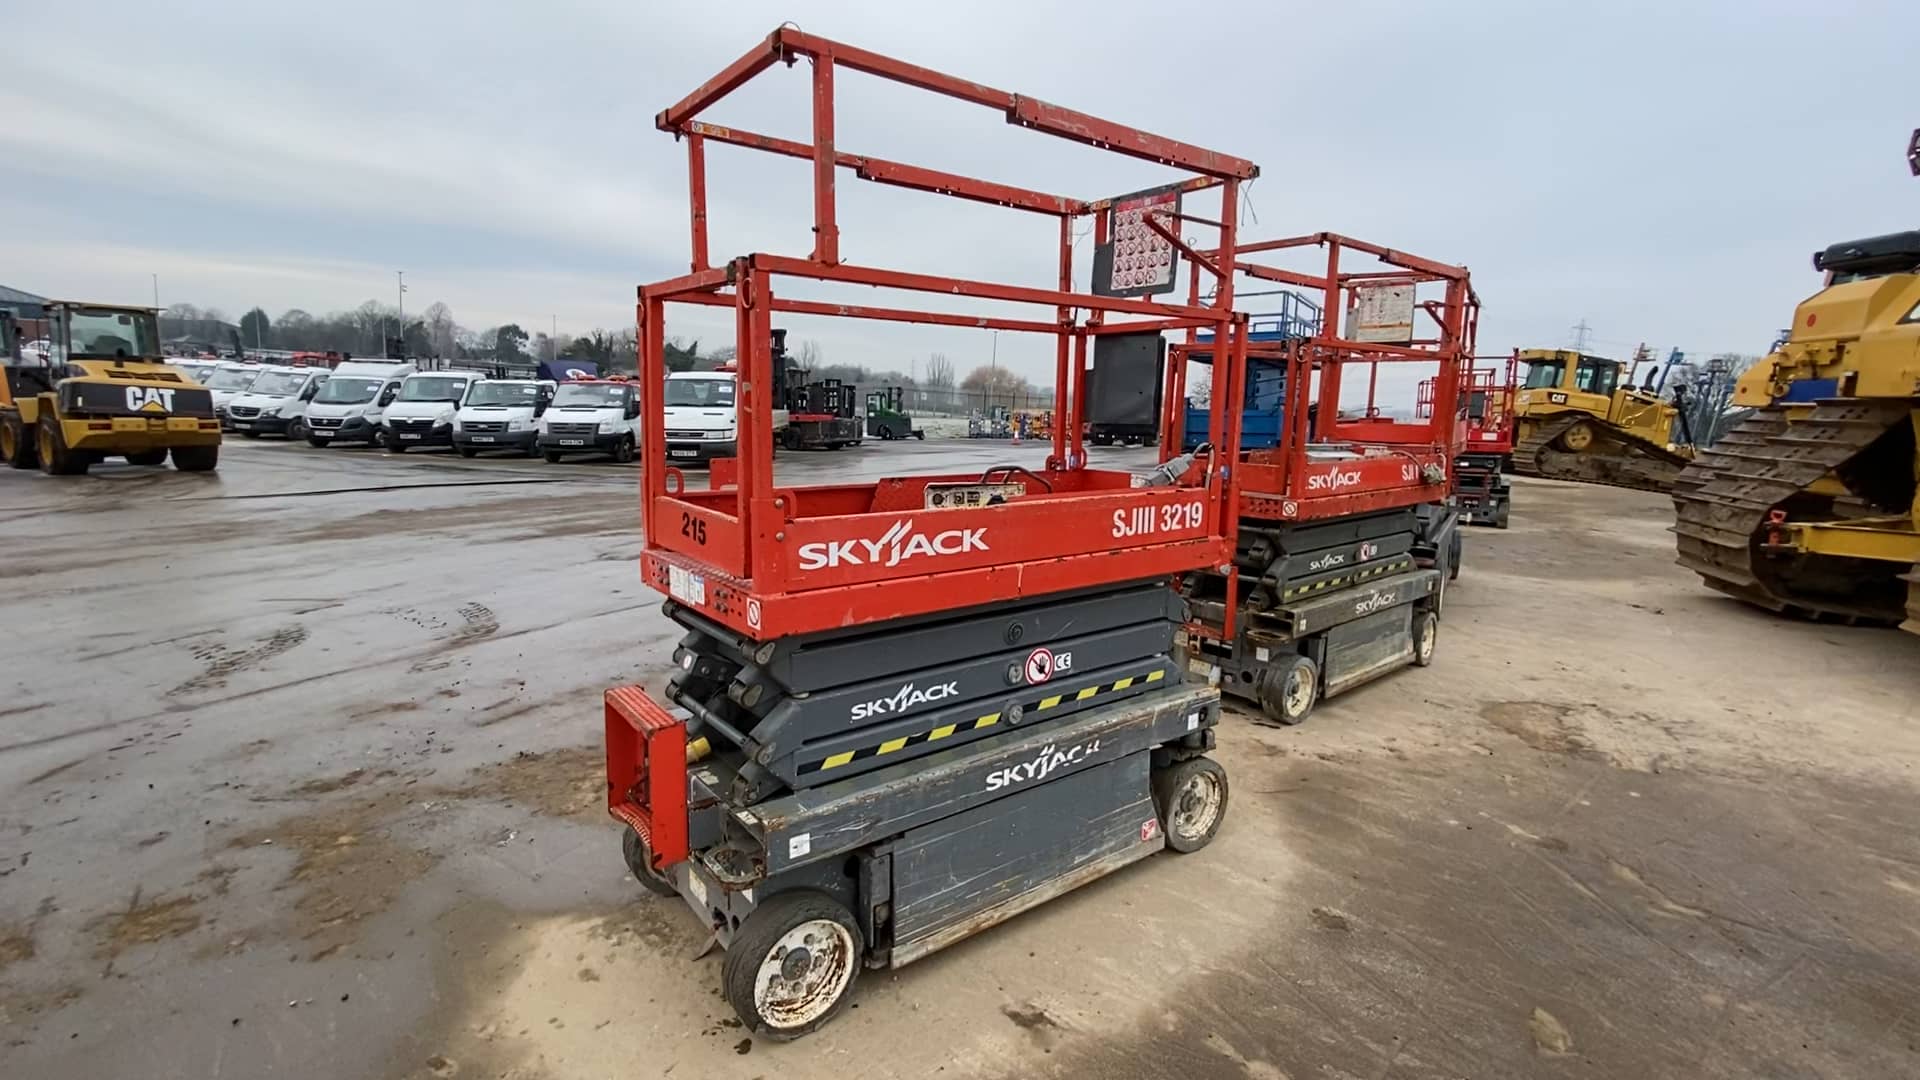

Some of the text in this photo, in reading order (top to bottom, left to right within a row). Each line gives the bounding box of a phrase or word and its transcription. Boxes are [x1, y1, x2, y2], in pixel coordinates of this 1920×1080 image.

[126, 386, 175, 412] CAT
[1552, 393, 1566, 403] CAT
[1308, 466, 1361, 490] SKYJACK
[682, 511, 706, 545] 215
[1112, 501, 1203, 538] SJIII 3219
[798, 518, 990, 570] SKYJACK
[1055, 654, 1071, 669] CE
[850, 681, 959, 720] SKYJACK
